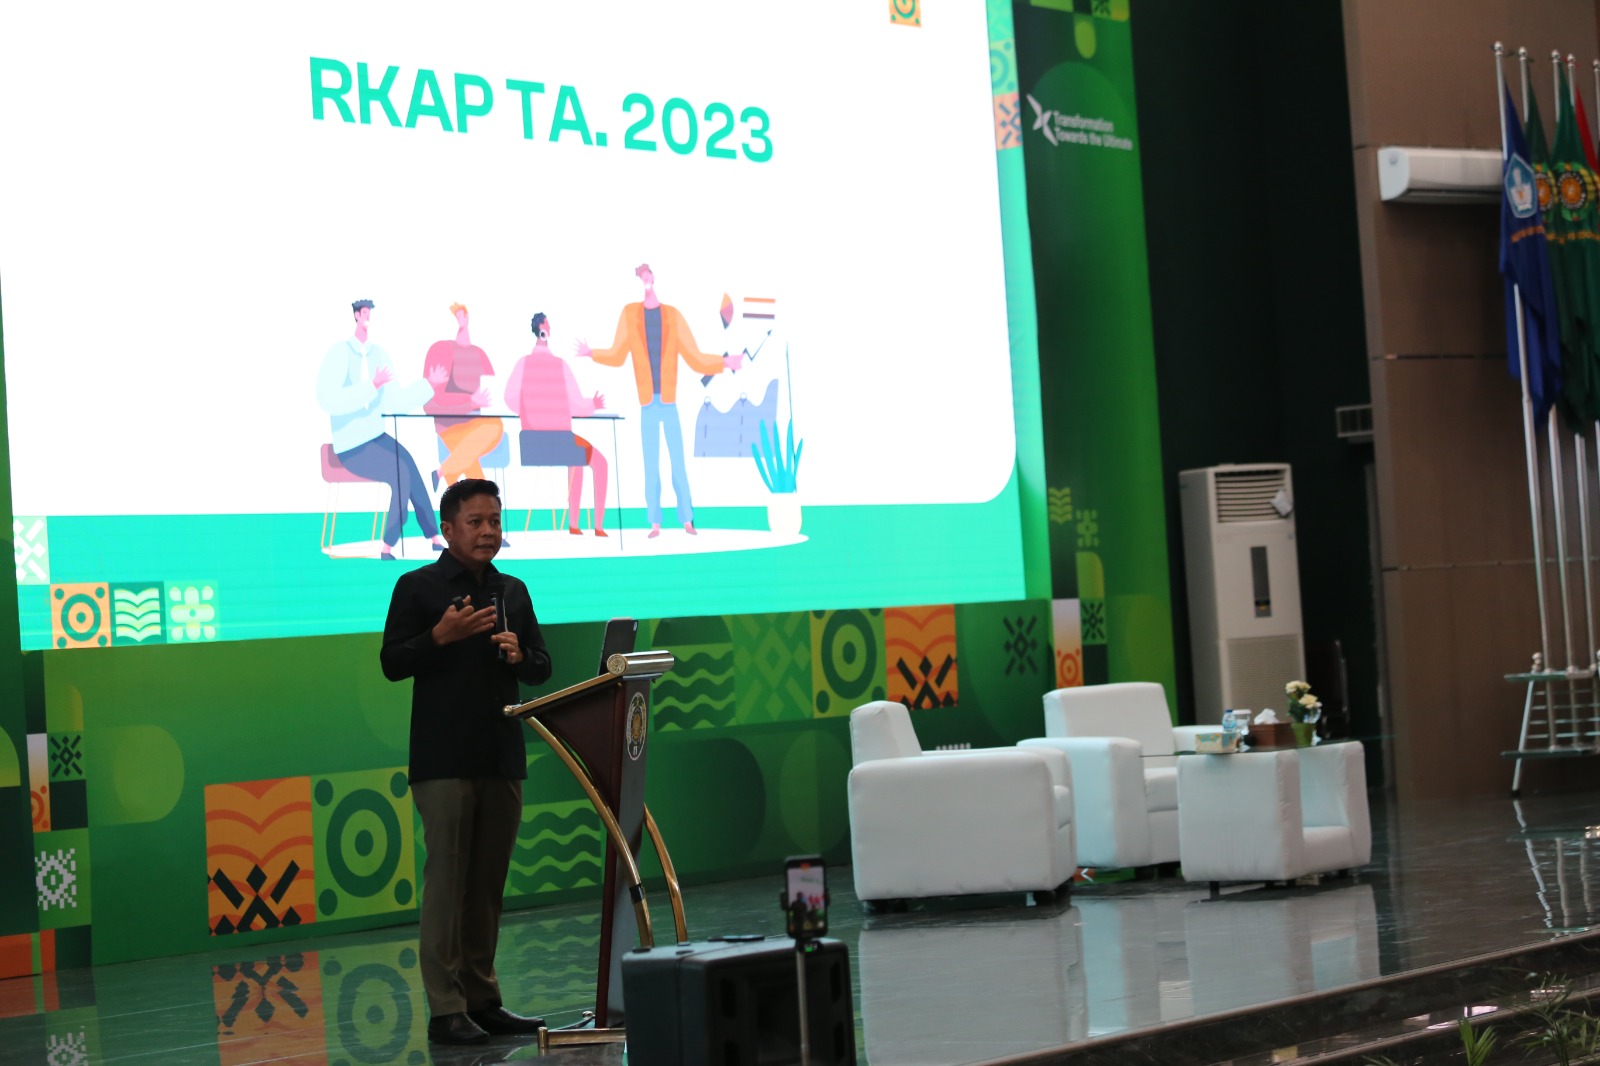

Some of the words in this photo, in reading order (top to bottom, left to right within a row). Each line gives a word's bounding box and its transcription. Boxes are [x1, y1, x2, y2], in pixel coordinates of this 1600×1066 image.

[310, 57, 493, 133] RKAP
[506, 79, 607, 146] TA.
[623, 93, 773, 162] 2023
[1053, 110, 1114, 132] Transformation
[1054, 126, 1088, 144] Towards
[1089, 132, 1102, 146] the
